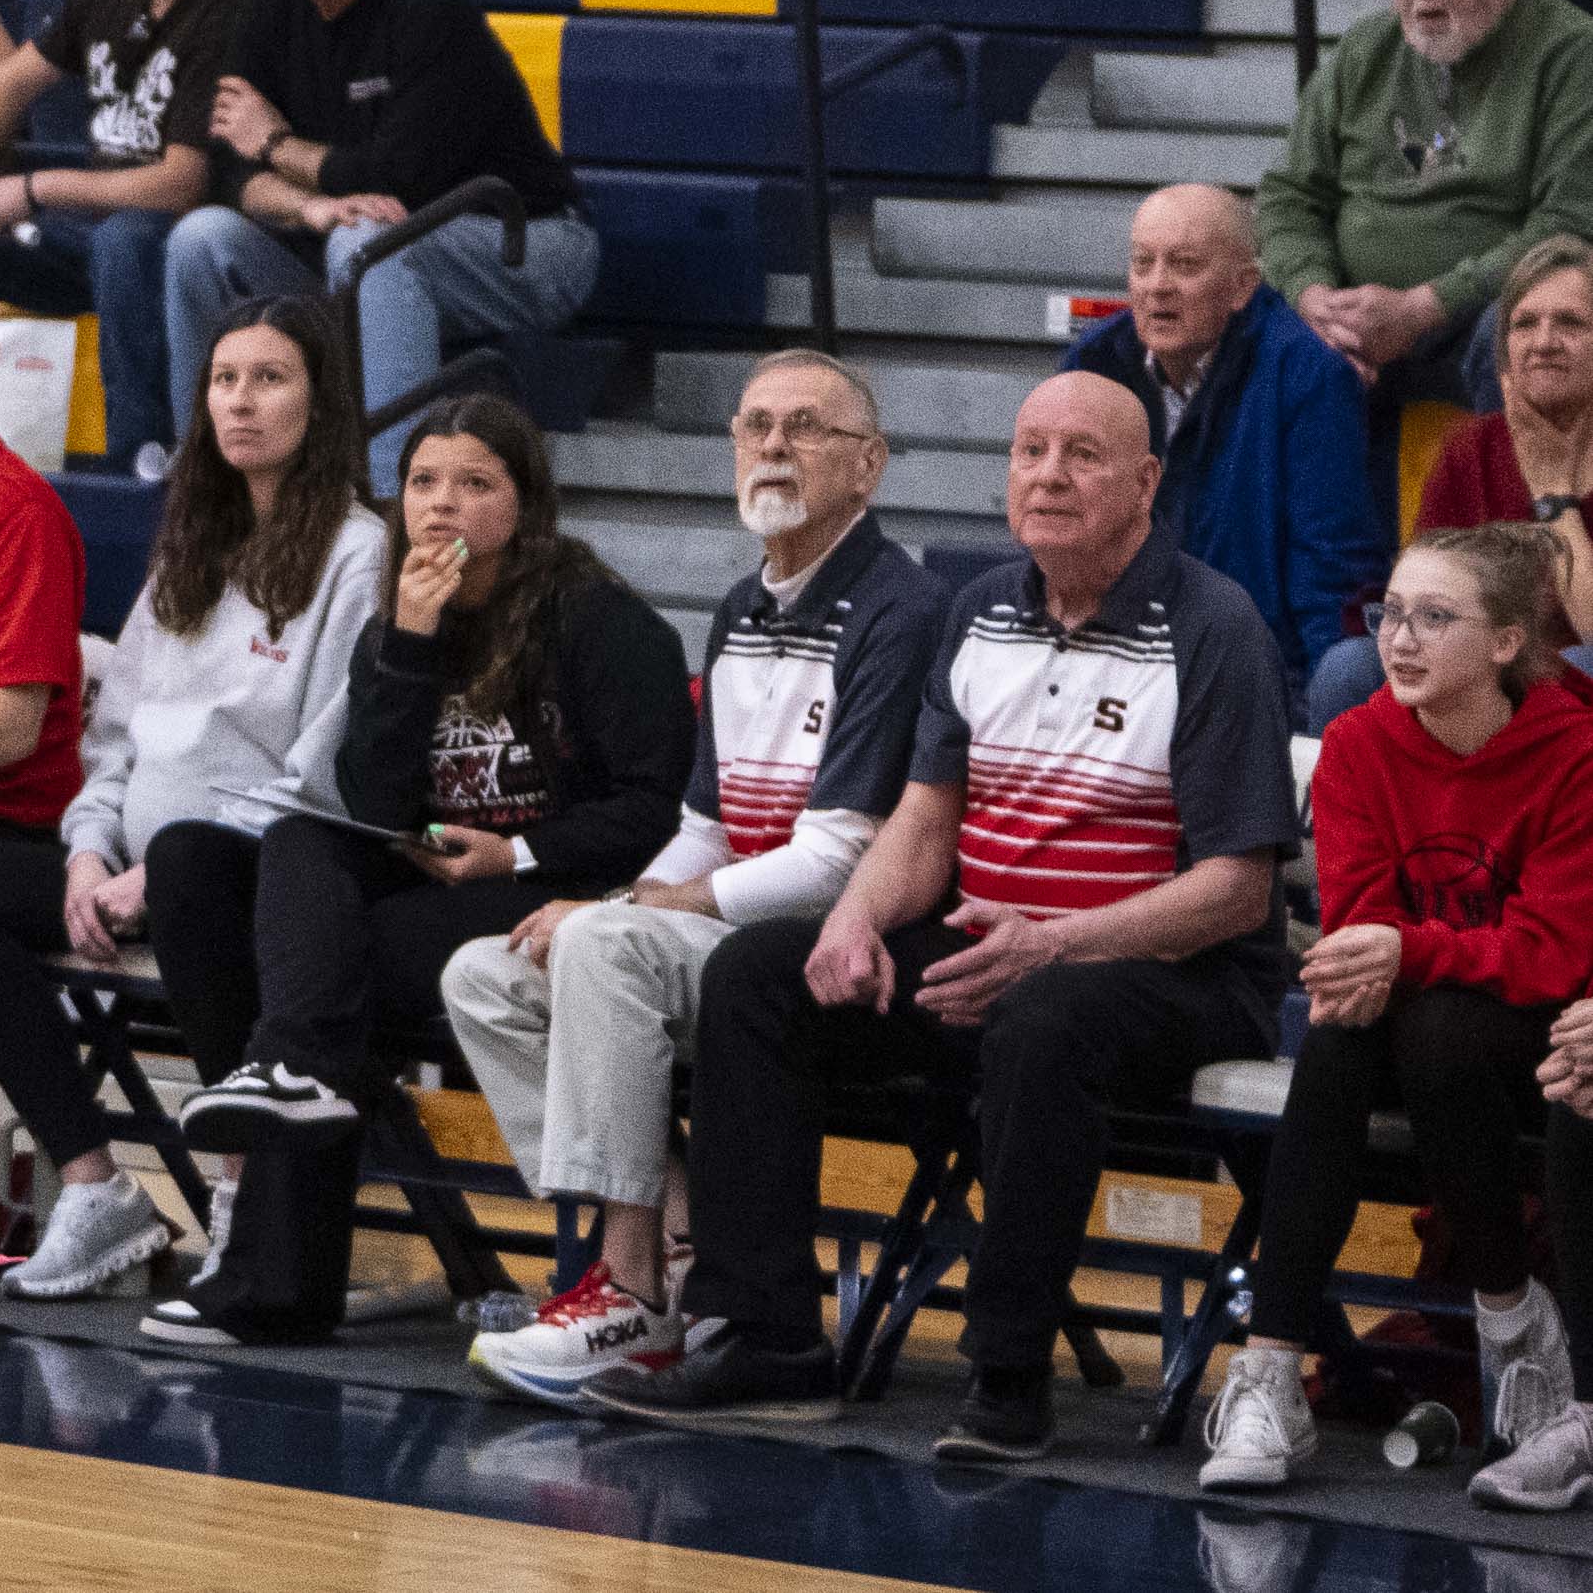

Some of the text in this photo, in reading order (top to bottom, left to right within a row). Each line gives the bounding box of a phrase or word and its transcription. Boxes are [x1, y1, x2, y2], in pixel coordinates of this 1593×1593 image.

[804, 699, 825, 734] S
[1092, 696, 1128, 734] S
[584, 1314, 649, 1354] HOKA
